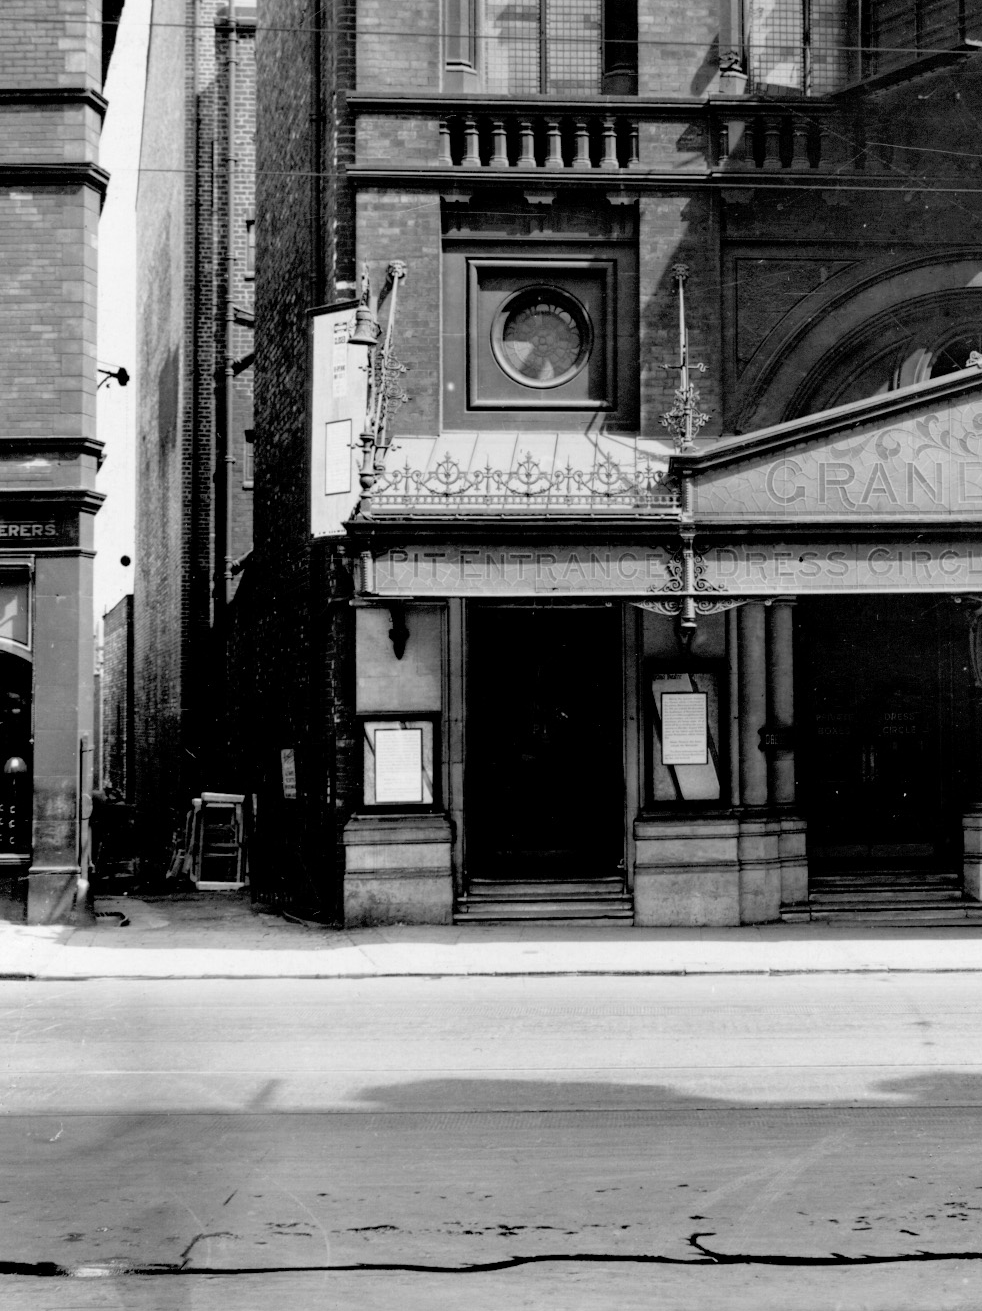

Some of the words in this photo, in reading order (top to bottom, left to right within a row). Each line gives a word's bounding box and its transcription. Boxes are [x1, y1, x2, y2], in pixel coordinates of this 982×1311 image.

[388, 549, 447, 580] PIT
[459, 550, 667, 583] ENTRANCE
[714, 547, 850, 582] DRESS
